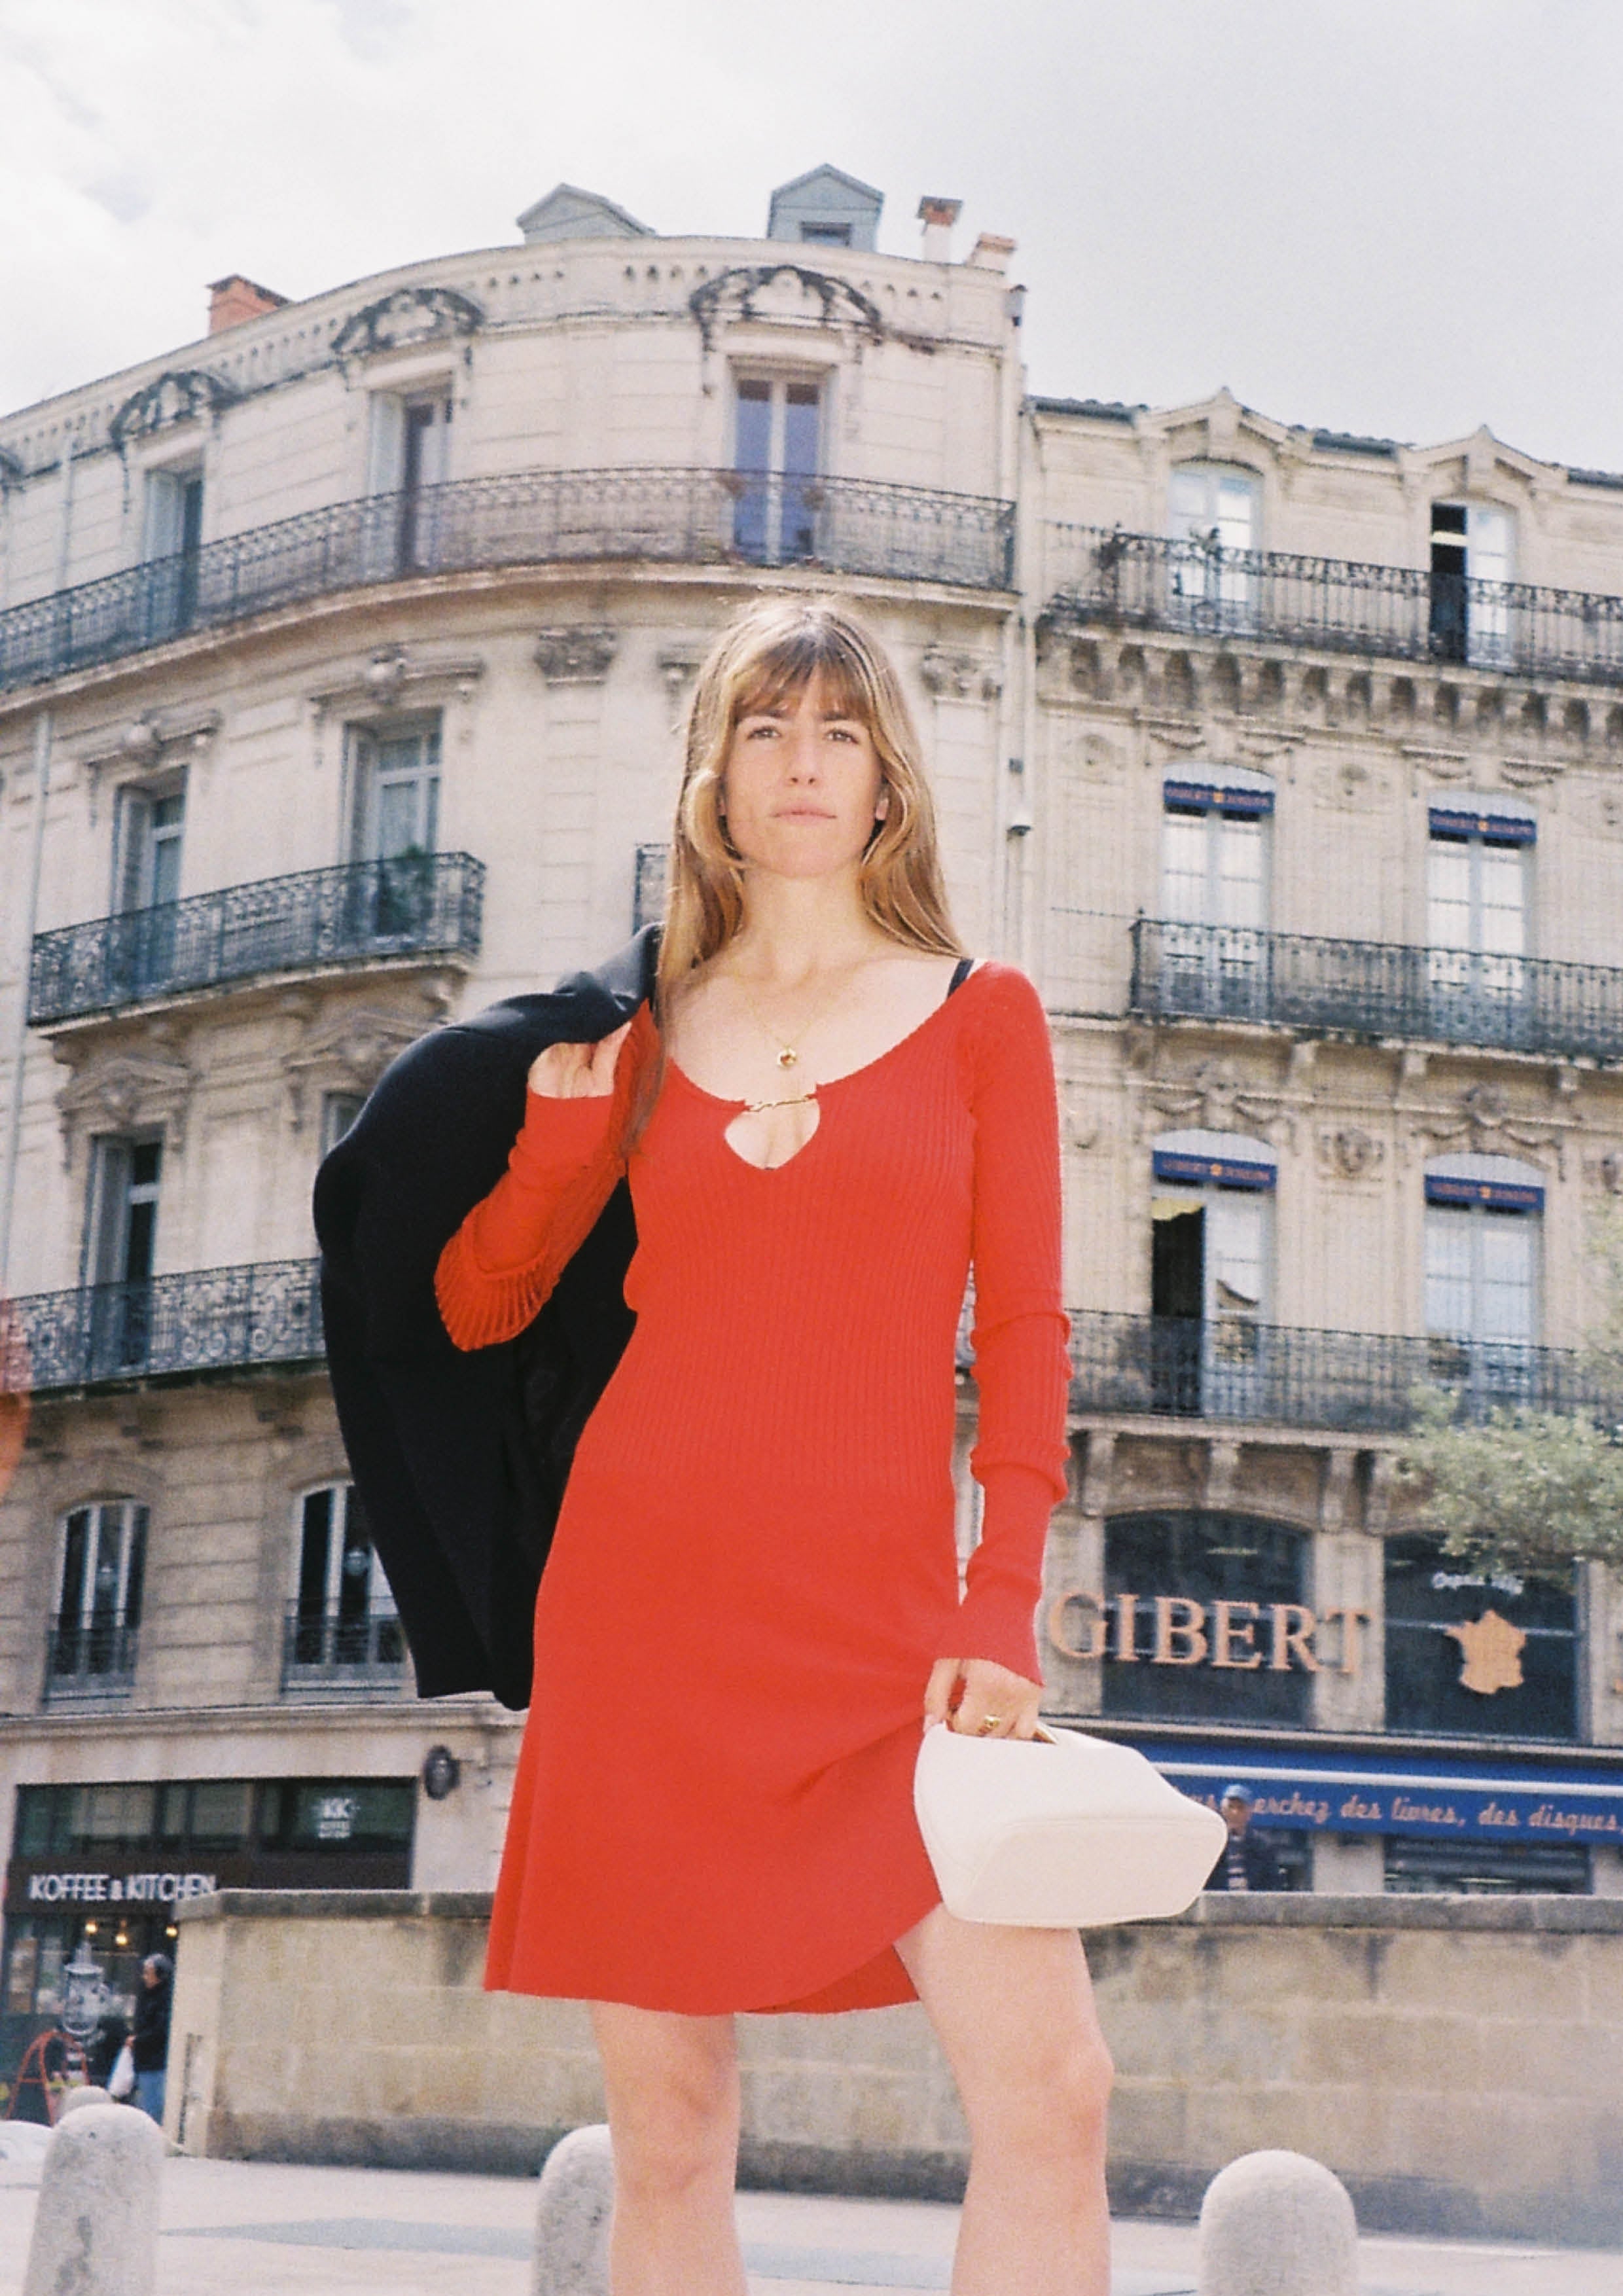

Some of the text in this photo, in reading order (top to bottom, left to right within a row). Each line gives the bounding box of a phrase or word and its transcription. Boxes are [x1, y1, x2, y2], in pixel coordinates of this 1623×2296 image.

[1049, 1590, 1372, 1673] GIBERT
[1253, 1791, 1330, 1824] erchez
[1340, 1794, 1382, 1820] des
[1391, 1797, 1466, 1827] livres,
[1478, 1802, 1520, 1826] des
[29, 1874, 109, 1901] KOFFEE
[125, 1873, 216, 1901] KITCHEN
